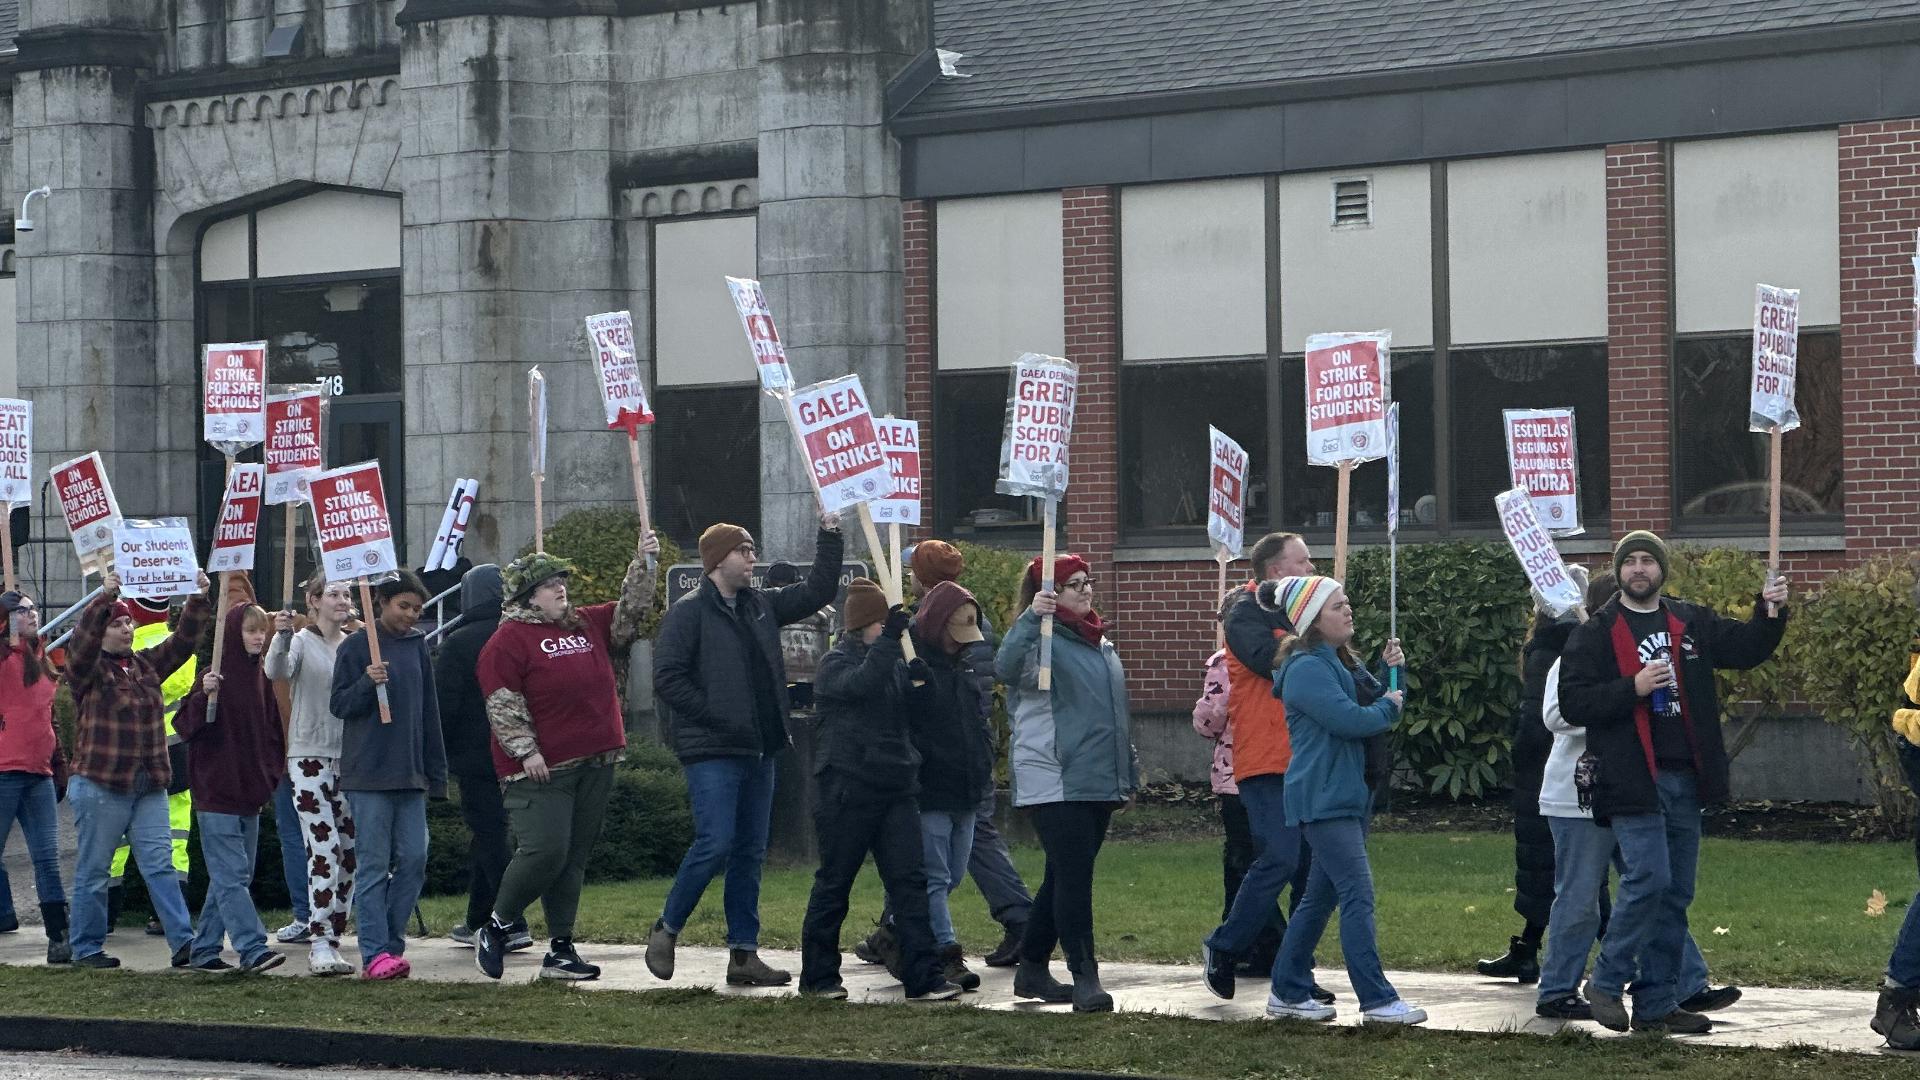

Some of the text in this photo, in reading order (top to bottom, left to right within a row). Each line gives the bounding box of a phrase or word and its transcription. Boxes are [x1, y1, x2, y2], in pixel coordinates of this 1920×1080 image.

[1760, 305, 1797, 334] GREAT
[1758, 332, 1795, 358] PUBLIC
[227, 354, 244, 367] ON
[1332, 349, 1351, 366] ON
[214, 368, 256, 381] STRIKE
[1021, 368, 1046, 379] GAEA
[1320, 365, 1367, 385] STRIKE
[207, 382, 261, 395] FOR SAFE
[606, 383, 629, 400] FOR
[1019, 380, 1074, 407] GREAT
[1316, 381, 1374, 402] FOR OUR
[1756, 375, 1779, 396] FOR
[0, 403, 27, 413] EMANDS
[207, 395, 260, 409] SCHOOLS
[287, 403, 302, 418] ON
[798, 388, 864, 426] GAEA
[1311, 397, 1382, 420] STUDENTS
[0, 413, 27, 431] EAT
[275, 417, 312, 434] STRIKE
[1514, 423, 1569, 438] ESCUELAS
[0, 433, 27, 449] BLIC
[271, 432, 316, 449] FOR OUR
[826, 427, 855, 451] ON
[878, 425, 916, 448] AEA
[0, 450, 27, 464] OOLS
[267, 446, 320, 465] STUDENTS
[1013, 443, 1050, 462] FOR
[1214, 437, 1243, 476] GAEA
[1517, 442, 1567, 454] SEGURAS Y
[814, 441, 881, 478] STRIKE
[890, 457, 903, 474] N
[1514, 458, 1573, 470] SALUDABLES
[5, 465, 28, 480] ALL
[67, 468, 81, 482] ON
[63, 478, 96, 499] STRIKE
[232, 471, 259, 493] EA
[335, 477, 355, 494] ON
[895, 476, 919, 494] IKE
[1222, 474, 1233, 494] ON
[1520, 473, 1570, 492] AHORA
[64, 488, 105, 512] FOR SAFE
[324, 490, 373, 511] STRIKE
[67, 501, 108, 525] SCHOOLS
[224, 504, 244, 521] ON
[322, 504, 379, 527] FOR OUR
[218, 522, 255, 541] TRIKE
[320, 518, 388, 543] STUDENTS
[1504, 507, 1536, 538] GRE
[121, 539, 189, 553] Our Students
[1514, 529, 1547, 558] PUB
[132, 556, 183, 567] Deserve:
[1525, 547, 1559, 574] SCHO
[126, 570, 134, 583] to
[138, 571, 149, 581] not
[152, 572, 162, 581] be
[678, 573, 701, 589] Grea
[1534, 566, 1565, 593] FOR
[137, 584, 178, 594] the crowd
